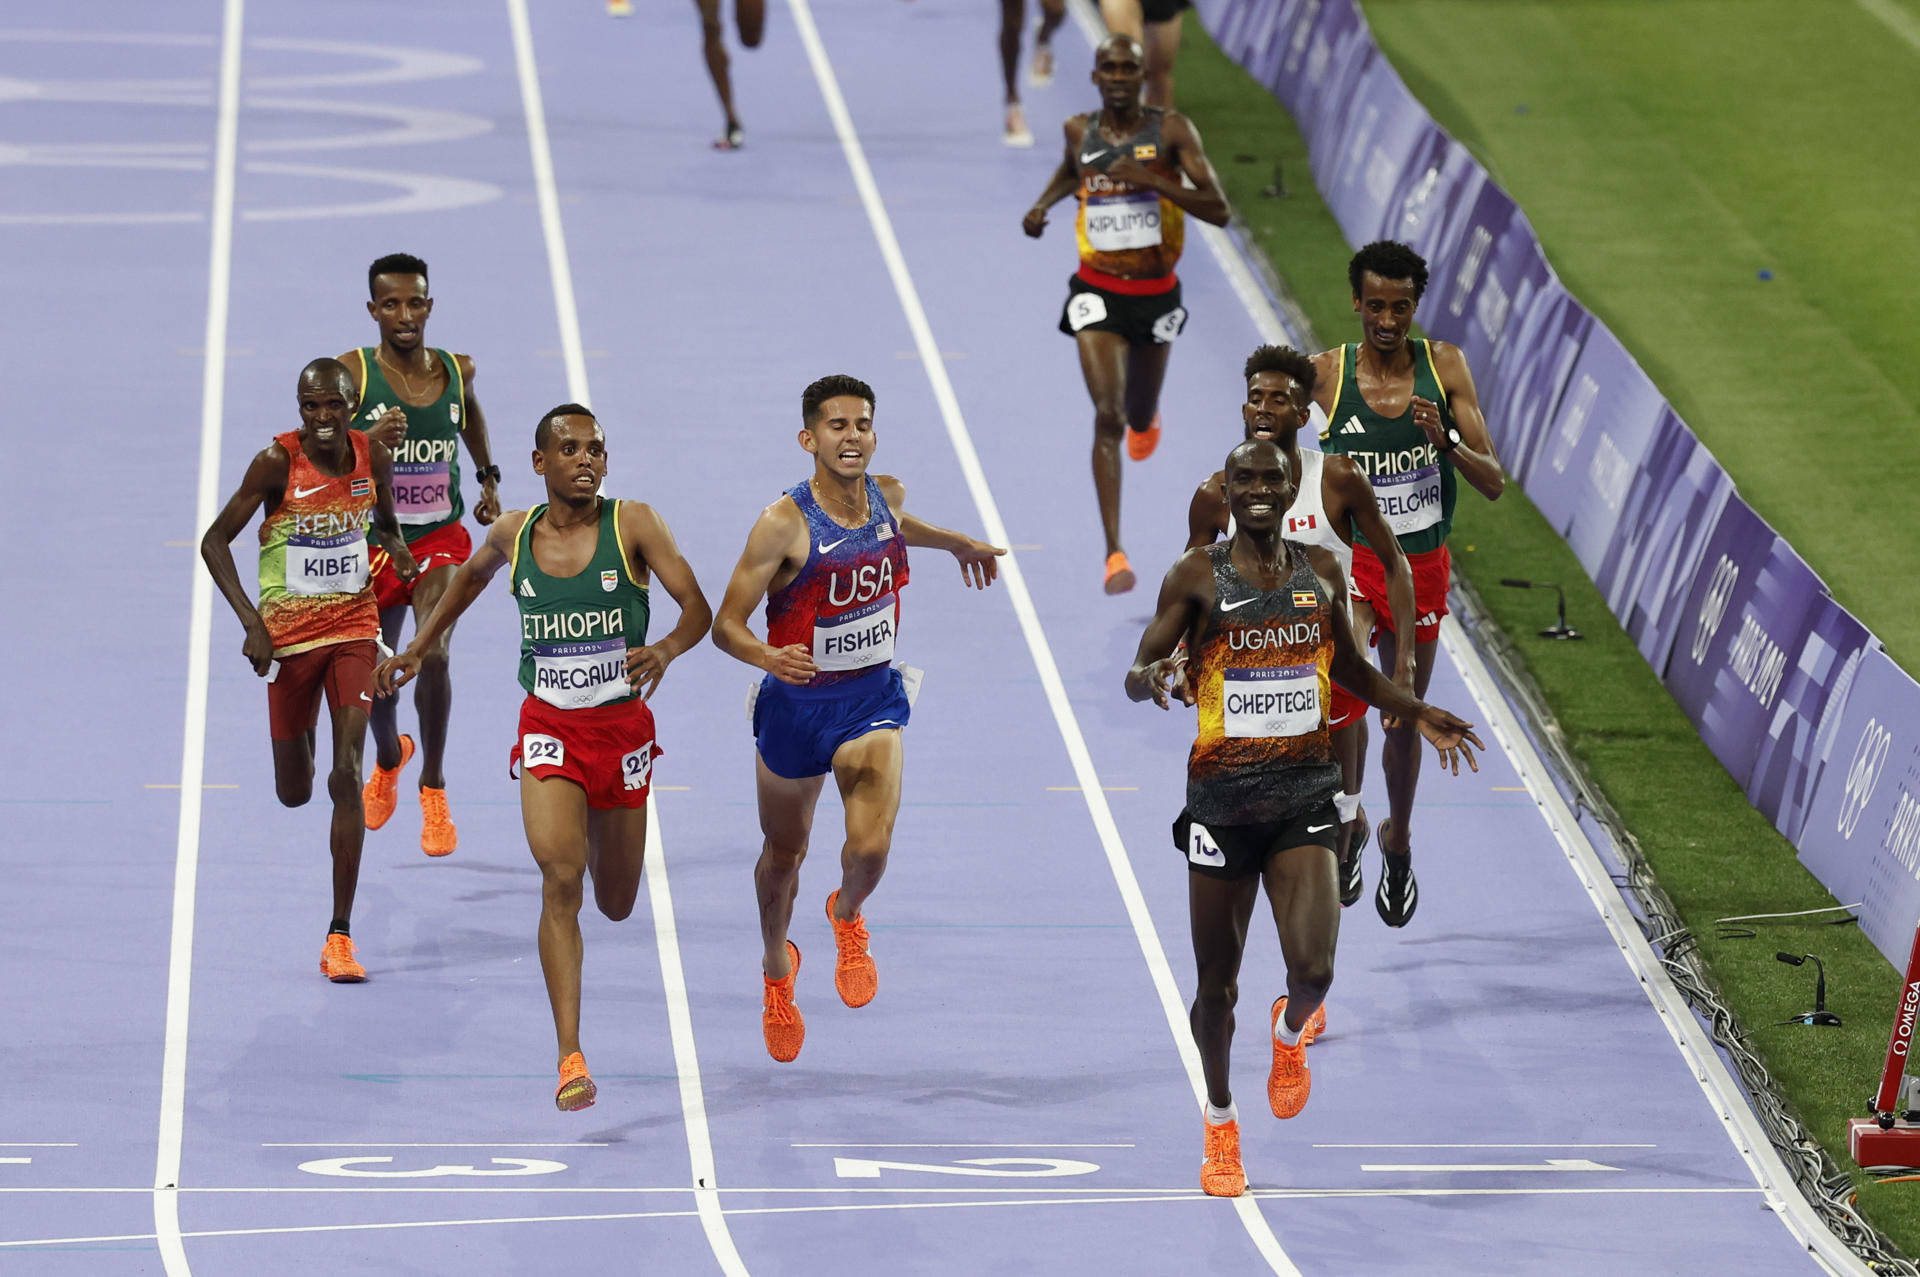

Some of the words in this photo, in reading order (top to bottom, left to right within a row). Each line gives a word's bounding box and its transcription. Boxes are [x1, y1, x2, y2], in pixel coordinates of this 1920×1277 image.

[1088, 211, 1160, 232] KIPLIMO
[1079, 302, 1090, 317] 5
[1165, 315, 1176, 331] 5
[393, 439, 456, 463] HIOPIA
[1377, 476, 1400, 484] PARIS
[391, 484, 445, 504] REGA
[1376, 485, 1440, 516] JELCHA
[304, 554, 359, 576] KIBET
[829, 557, 893, 606] USA
[523, 608, 623, 639] ETHIOPIA
[840, 611, 860, 622] PARIS
[825, 620, 892, 654] FISHER
[1229, 623, 1321, 650] UGANDA
[580, 645, 602, 653] 2024
[537, 660, 625, 690] AREGAWI
[1227, 688, 1315, 714] CHEPTEGEI
[529, 741, 559, 759] 22
[626, 750, 649, 775] 22
[1898, 981, 1920, 1037] OMEGA
[298, 1156, 567, 1177] 3
[835, 1157, 1101, 1178] 2
[1360, 1159, 1626, 1172] 1
